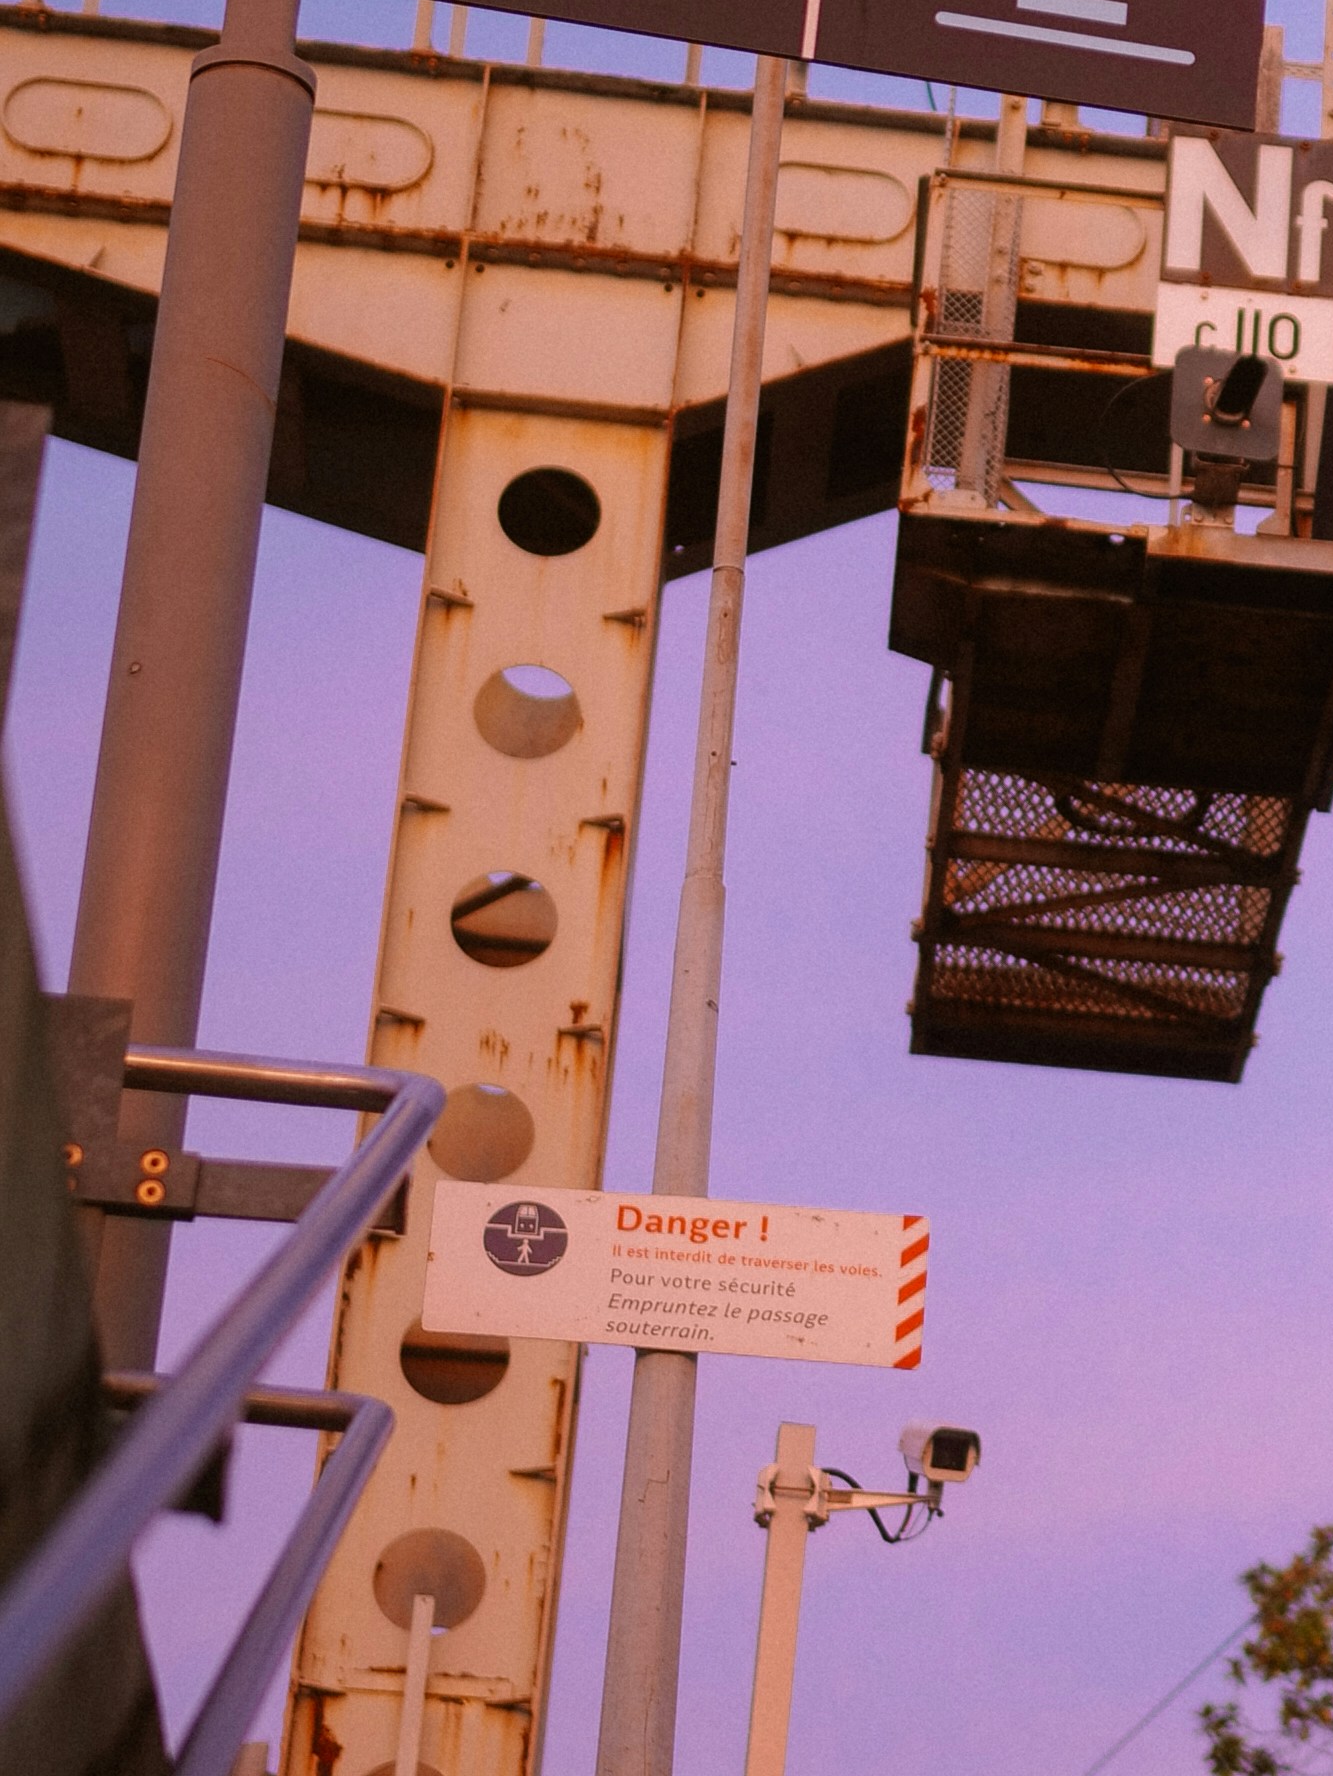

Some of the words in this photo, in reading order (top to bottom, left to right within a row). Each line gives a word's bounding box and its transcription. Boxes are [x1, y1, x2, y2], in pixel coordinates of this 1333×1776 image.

[616, 1204, 748, 1244] Danger
[760, 1215, 768, 1242] !
[627, 1247, 649, 1259] est
[655, 1247, 711, 1264] interdit
[718, 1253, 736, 1265] de
[741, 1255, 809, 1271] traverser
[814, 1260, 834, 1273] les
[840, 1263, 882, 1278] voies.
[610, 1268, 655, 1286] Pour
[660, 1275, 712, 1291] votre
[718, 1277, 796, 1297] sécurité
[608, 1293, 718, 1317] Empruntez
[724, 1303, 742, 1319] le
[746, 1307, 829, 1329] passage
[605, 1320, 714, 1341] souterrain.
